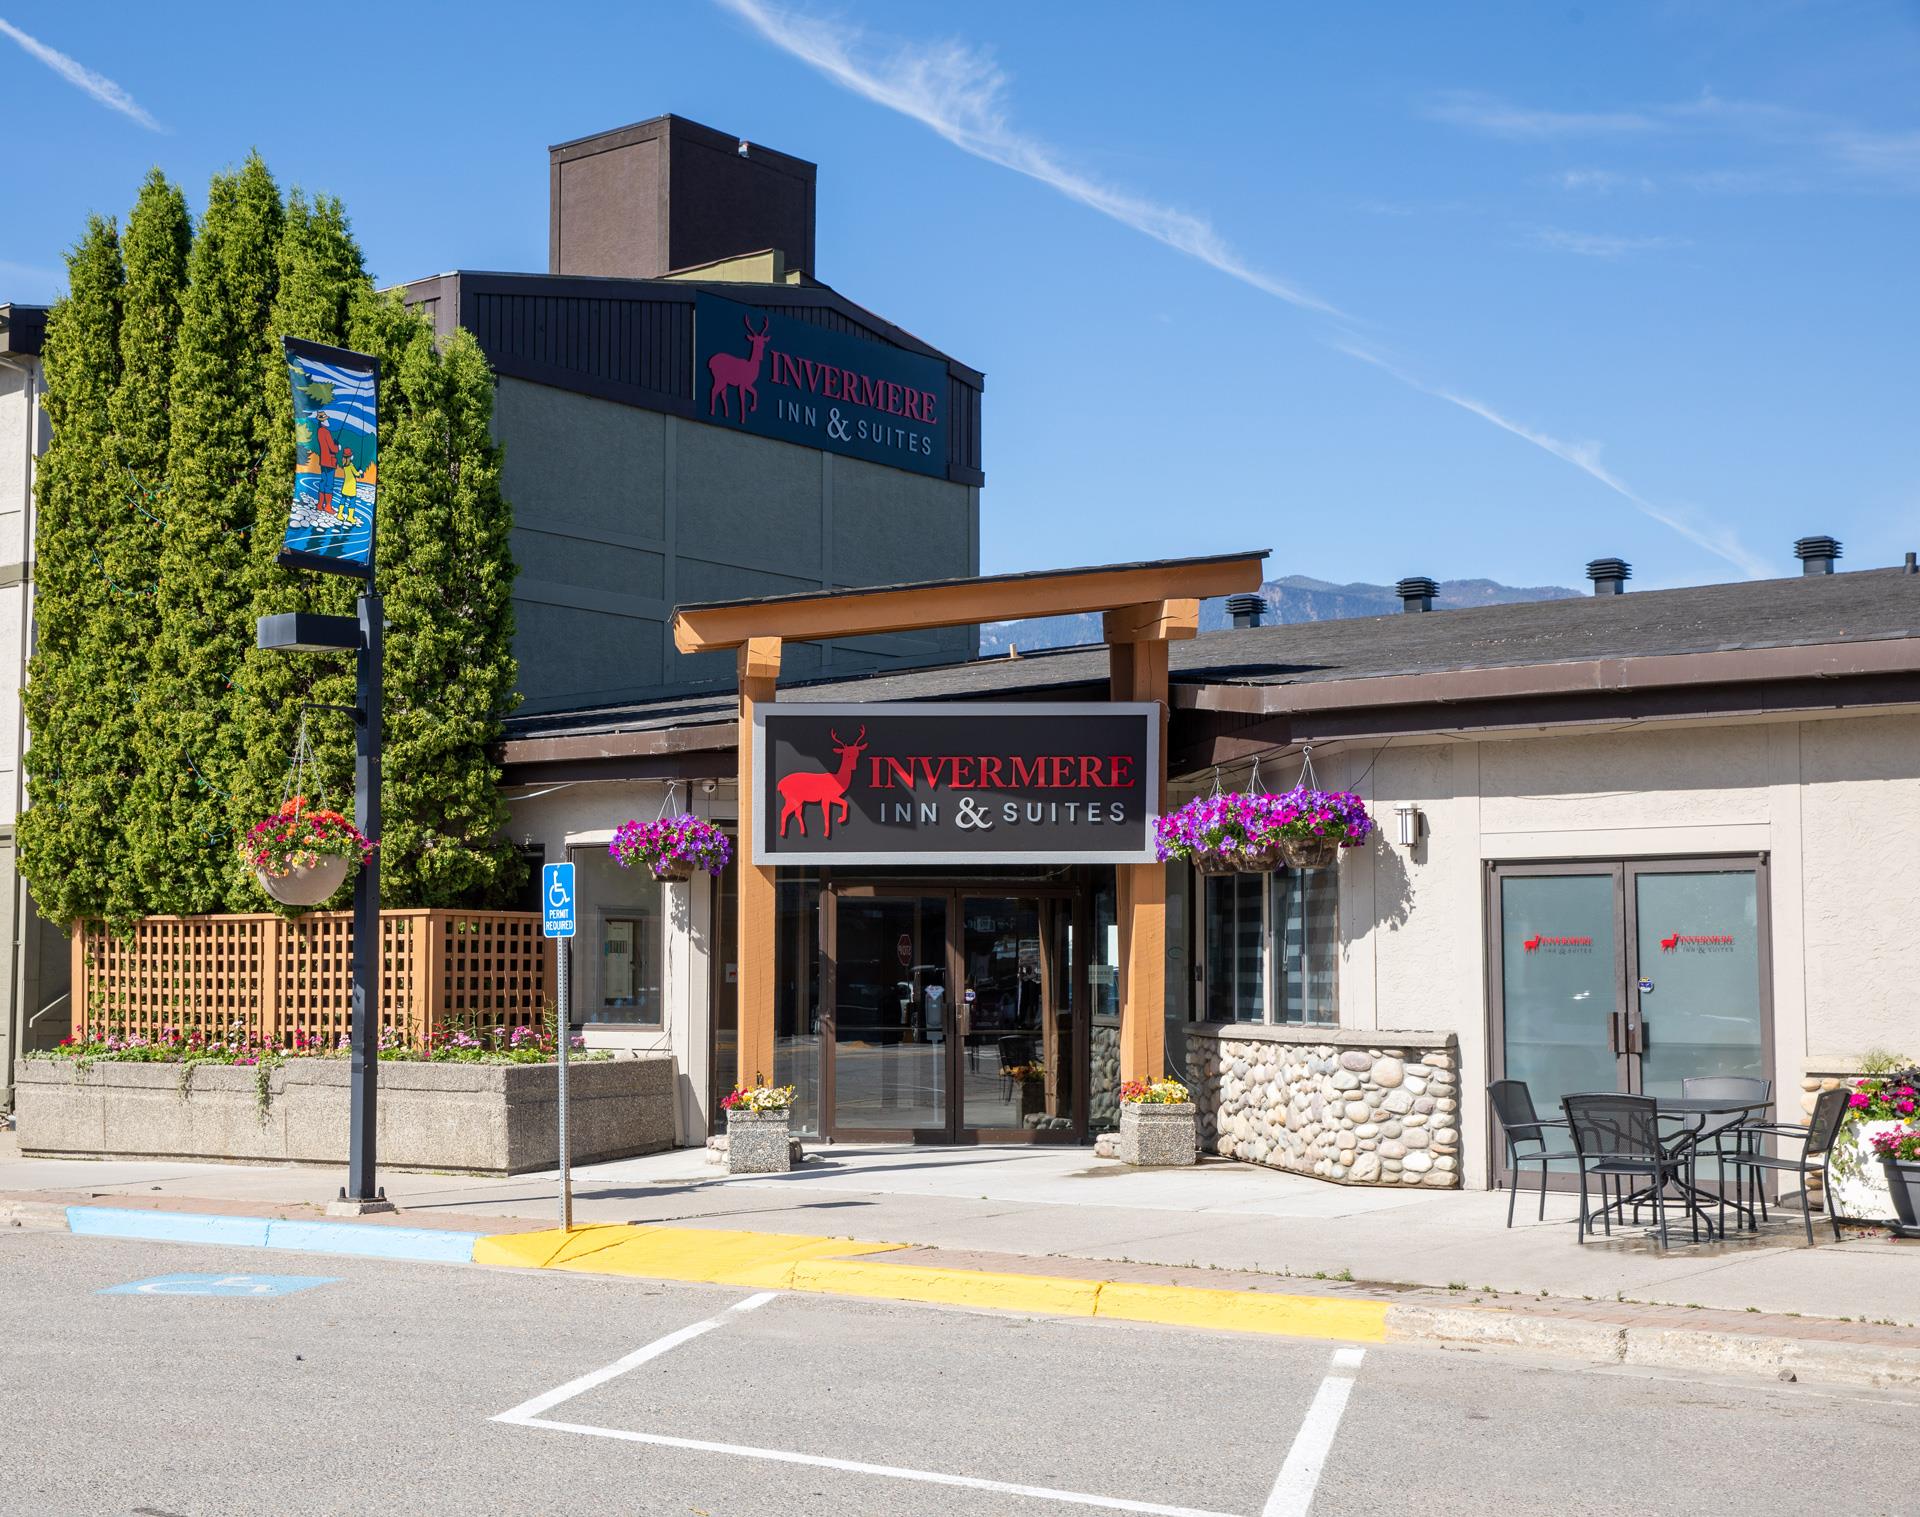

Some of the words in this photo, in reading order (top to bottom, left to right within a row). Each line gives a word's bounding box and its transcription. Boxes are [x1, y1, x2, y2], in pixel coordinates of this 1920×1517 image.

[769, 350, 938, 424] INVERMERE
[778, 399, 817, 427] INN
[827, 407, 851, 441] &
[857, 420, 932, 456] SUITES
[868, 756, 1135, 789] INVERMERE
[880, 803, 938, 822] INN
[955, 797, 993, 830] &
[1002, 802, 1125, 823] SUITES
[545, 920, 573, 930] REQUIRED
[549, 909, 569, 919] PERMIT
[1680, 935, 1733, 944] INVERMERE
